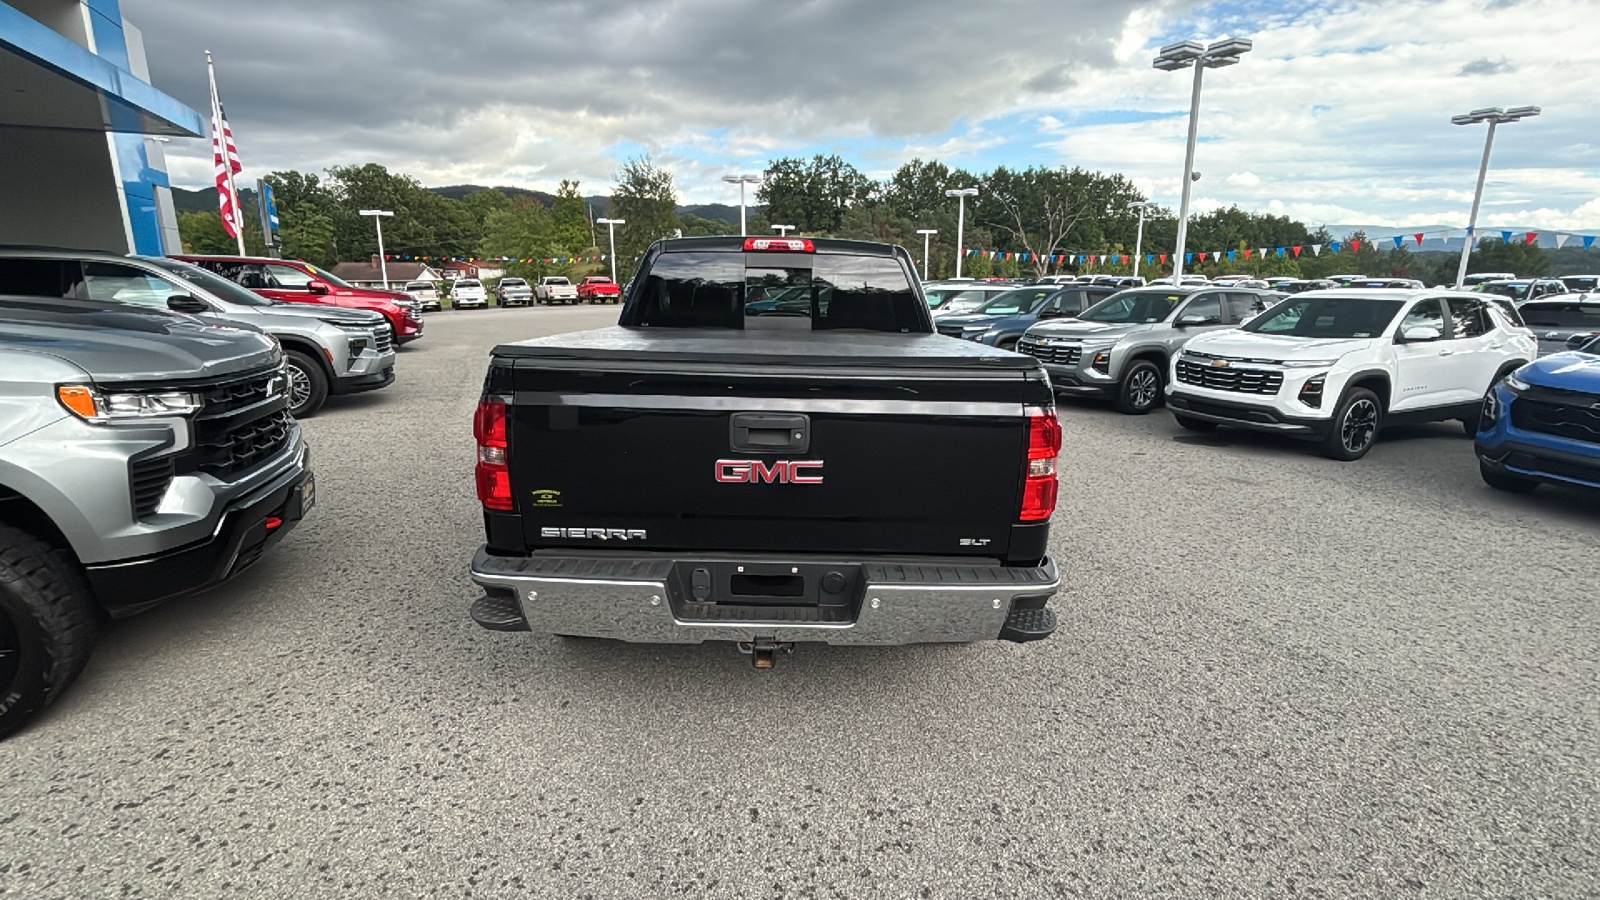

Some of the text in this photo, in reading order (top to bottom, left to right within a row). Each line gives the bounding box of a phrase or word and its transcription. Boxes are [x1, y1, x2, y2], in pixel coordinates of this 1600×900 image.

[715, 459, 824, 484] GMC
[541, 527, 647, 540] SIERRA
[959, 538, 991, 546] SLT
